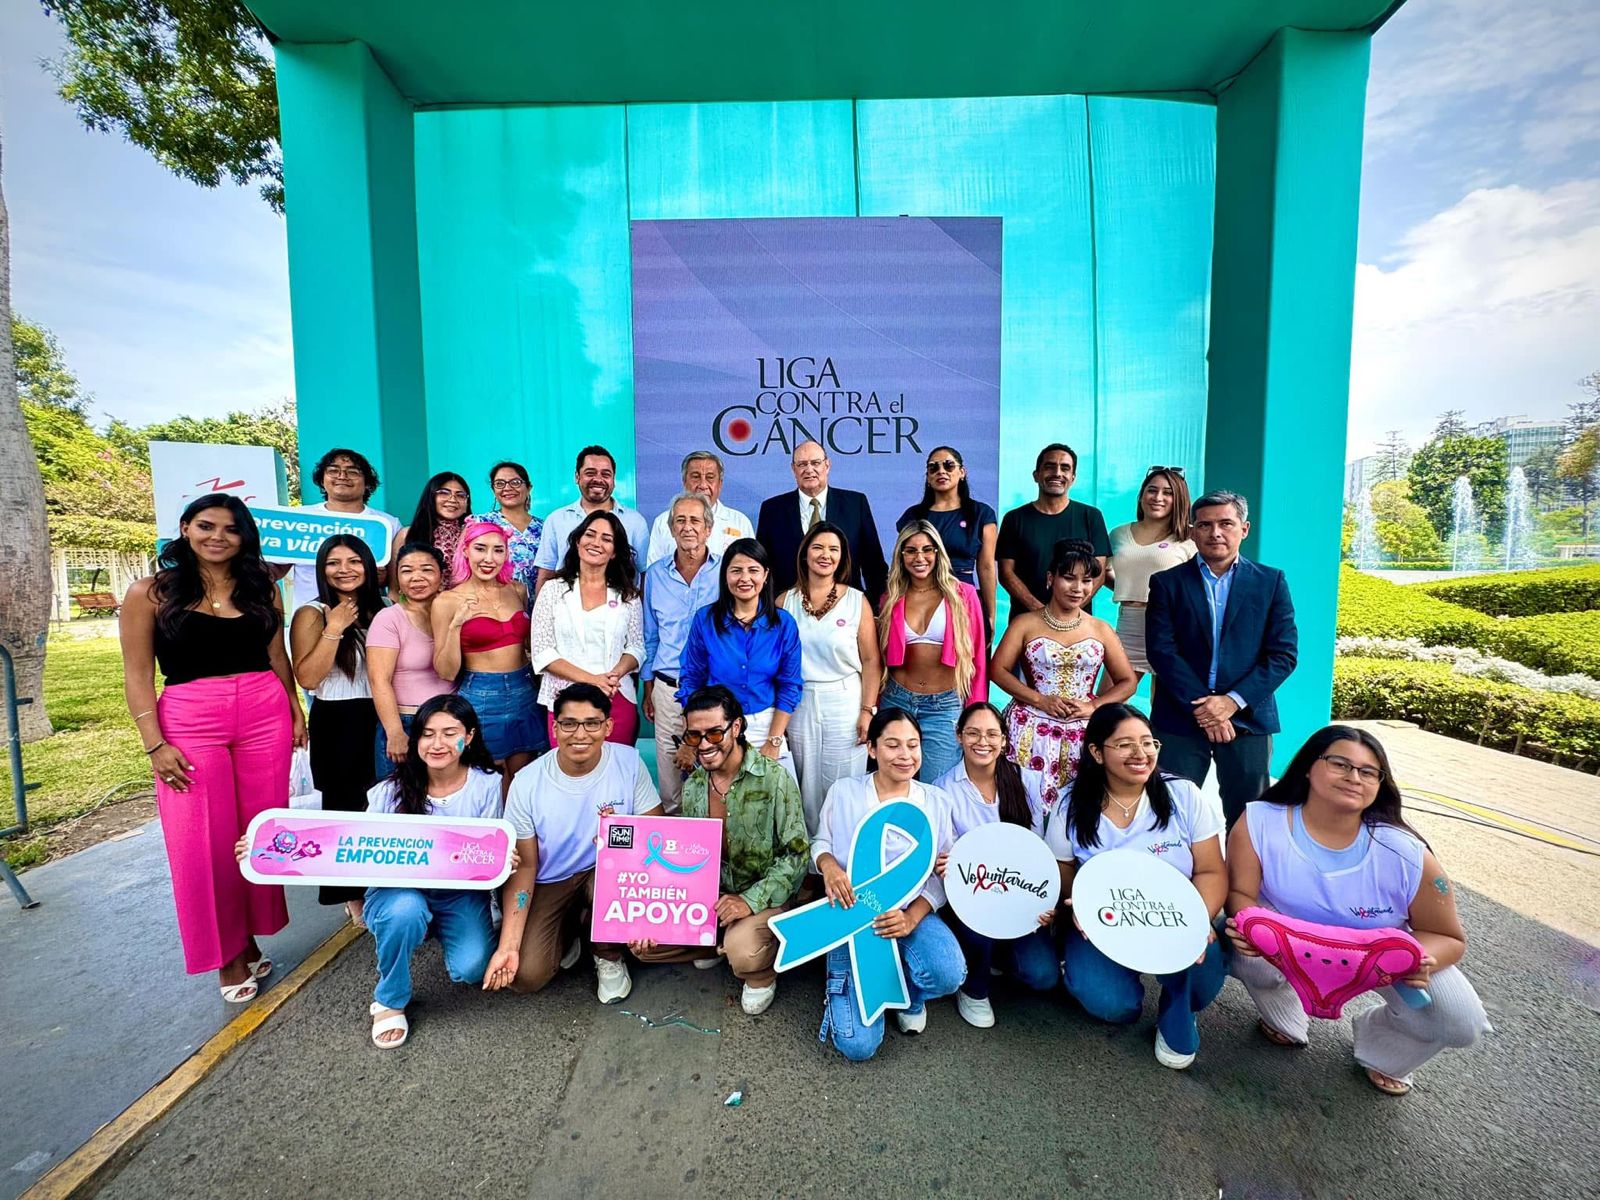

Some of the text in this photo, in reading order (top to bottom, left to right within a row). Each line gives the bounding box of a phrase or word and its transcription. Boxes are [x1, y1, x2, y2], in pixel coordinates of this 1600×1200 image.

[756, 357, 841, 389] LIGA
[756, 391, 904, 415] CONTRA el
[712, 405, 923, 456] CÁNCER
[338, 835, 354, 847] LA
[336, 848, 430, 866] EMPODERA
[617, 871, 650, 885] #YO
[957, 862, 1048, 899] Voluntariado
[618, 885, 687, 901] TAMBIÉN
[1109, 888, 1146, 901] LIGA
[603, 900, 709, 926] APOYO
[1112, 901, 1175, 911] CONTRA el
